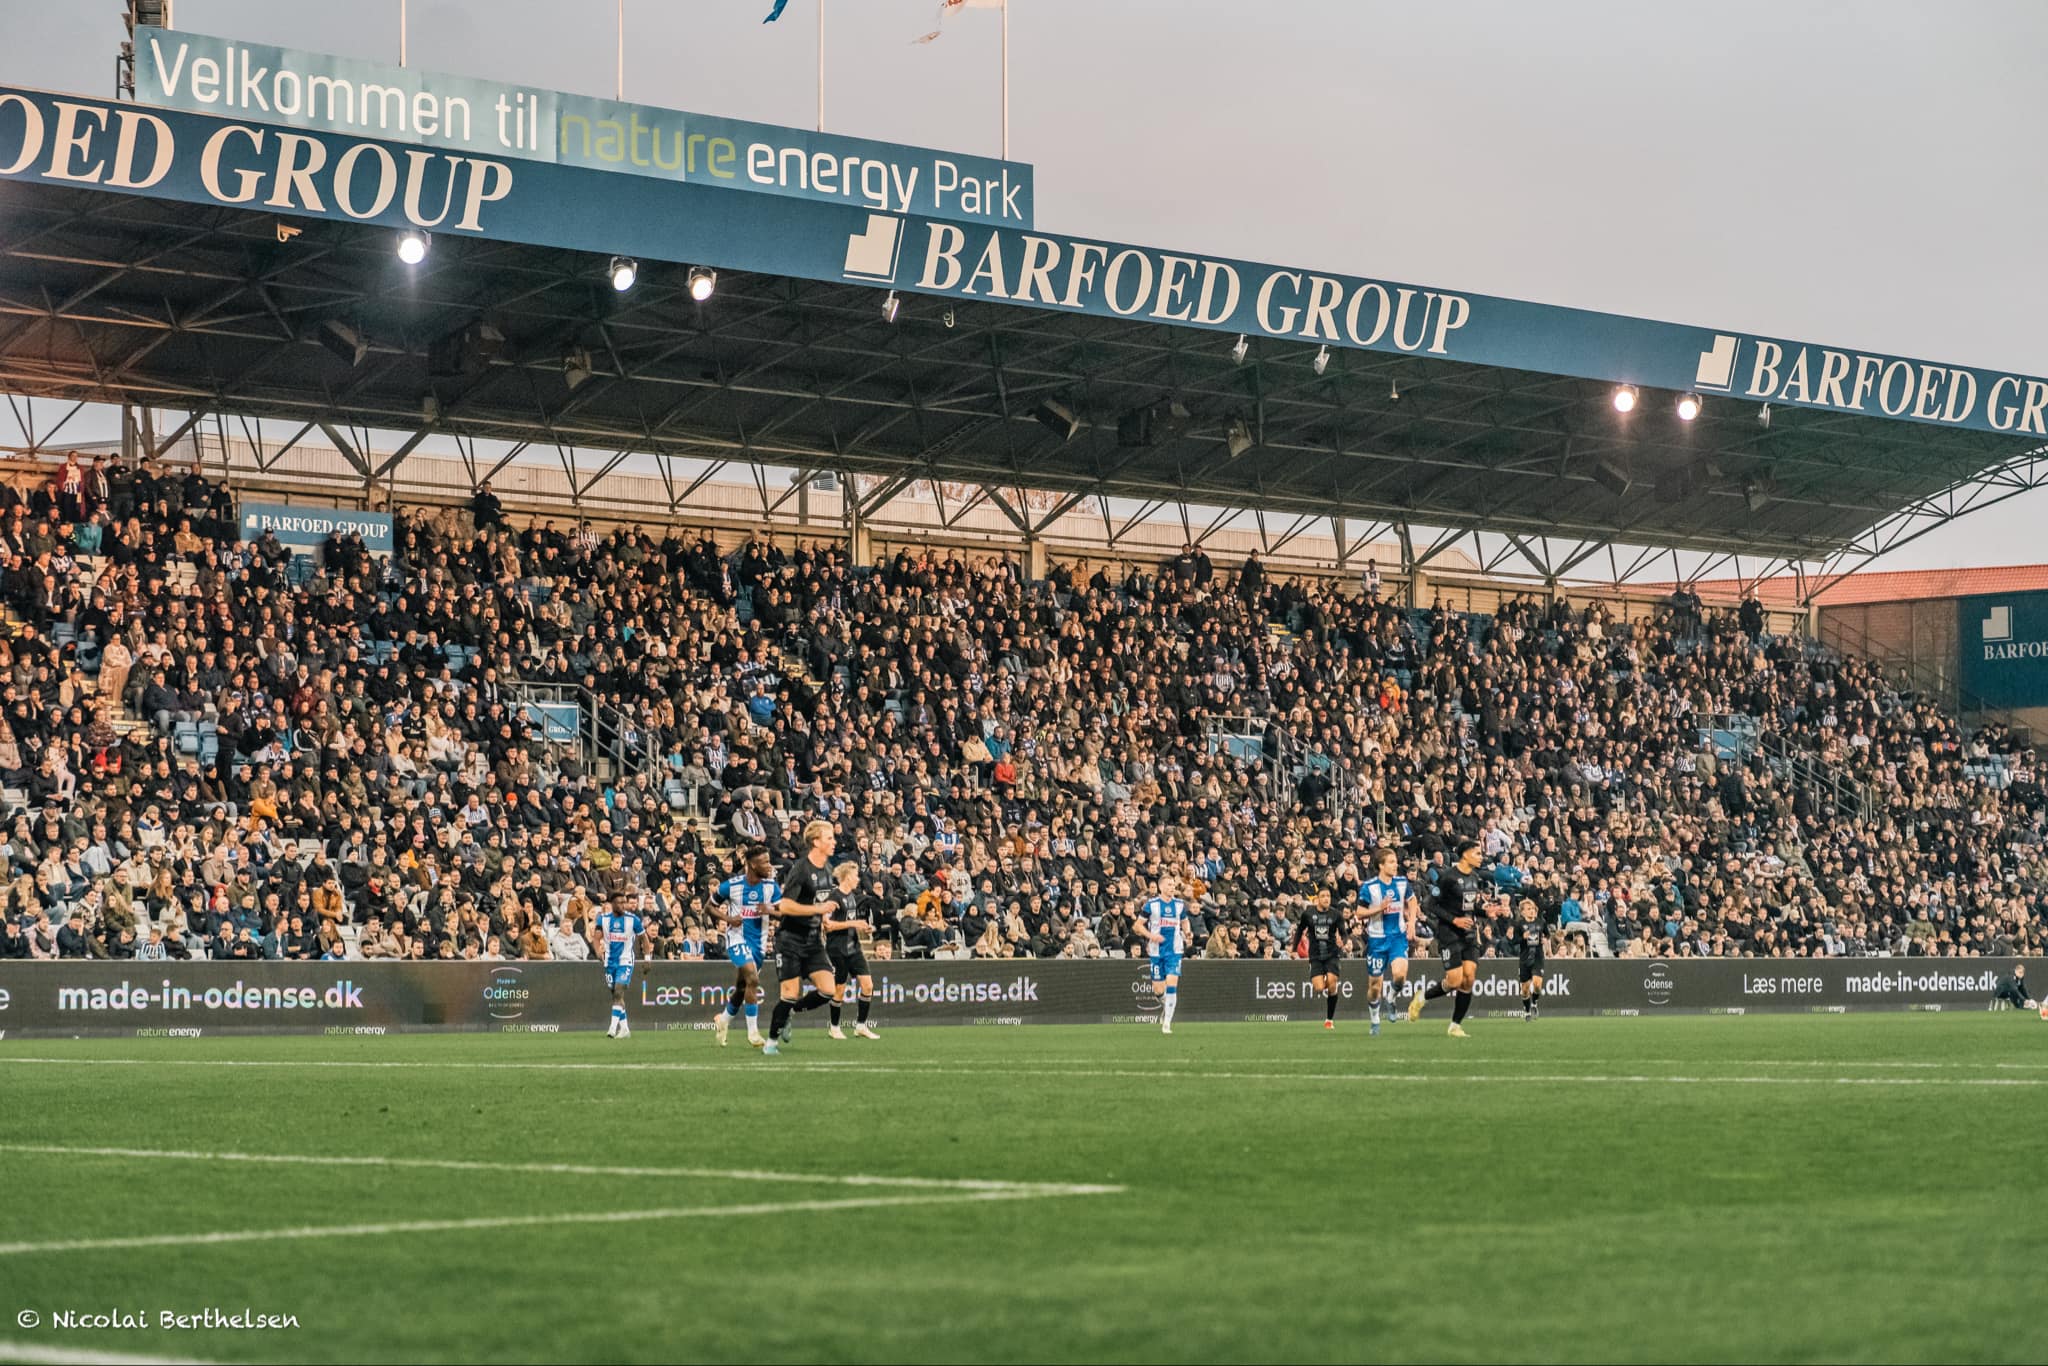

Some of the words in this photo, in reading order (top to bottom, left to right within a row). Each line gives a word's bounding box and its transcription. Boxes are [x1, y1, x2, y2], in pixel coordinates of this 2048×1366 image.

[150, 38, 470, 141] Velkommen
[495, 92, 538, 151] til
[561, 112, 736, 179] nature
[747, 143, 918, 213] energy
[934, 159, 1022, 220] Park
[200, 125, 513, 231] GROUP
[915, 222, 1240, 325] BARFOED
[1256, 271, 1470, 354] GROUP
[1745, 340, 1977, 423] BARFOED
[261, 514, 333, 534] BARFOED
[336, 520, 388, 538] GROUP
[1371, 957, 1384, 969] 18
[483, 986, 529, 999] Odense
[642, 980, 693, 1006] Læs
[700, 985, 765, 1005] mee
[803, 977, 1038, 1003] d-in-odense.dk
[1255, 976, 1296, 999] Læs
[1643, 978, 1673, 990] Odense
[1743, 974, 1776, 994] Læs
[1781, 977, 1823, 993] mere
[1846, 971, 1999, 992] made-in-odense.dk
[58, 980, 364, 1010] made-in-odense.dk
[354, 1026, 386, 1035] energy
[530, 1023, 560, 1033] energy
[997, 1017, 1022, 1026] energy
[1135, 1015, 1158, 1024] energy
[168, 1027, 202, 1038] energy
